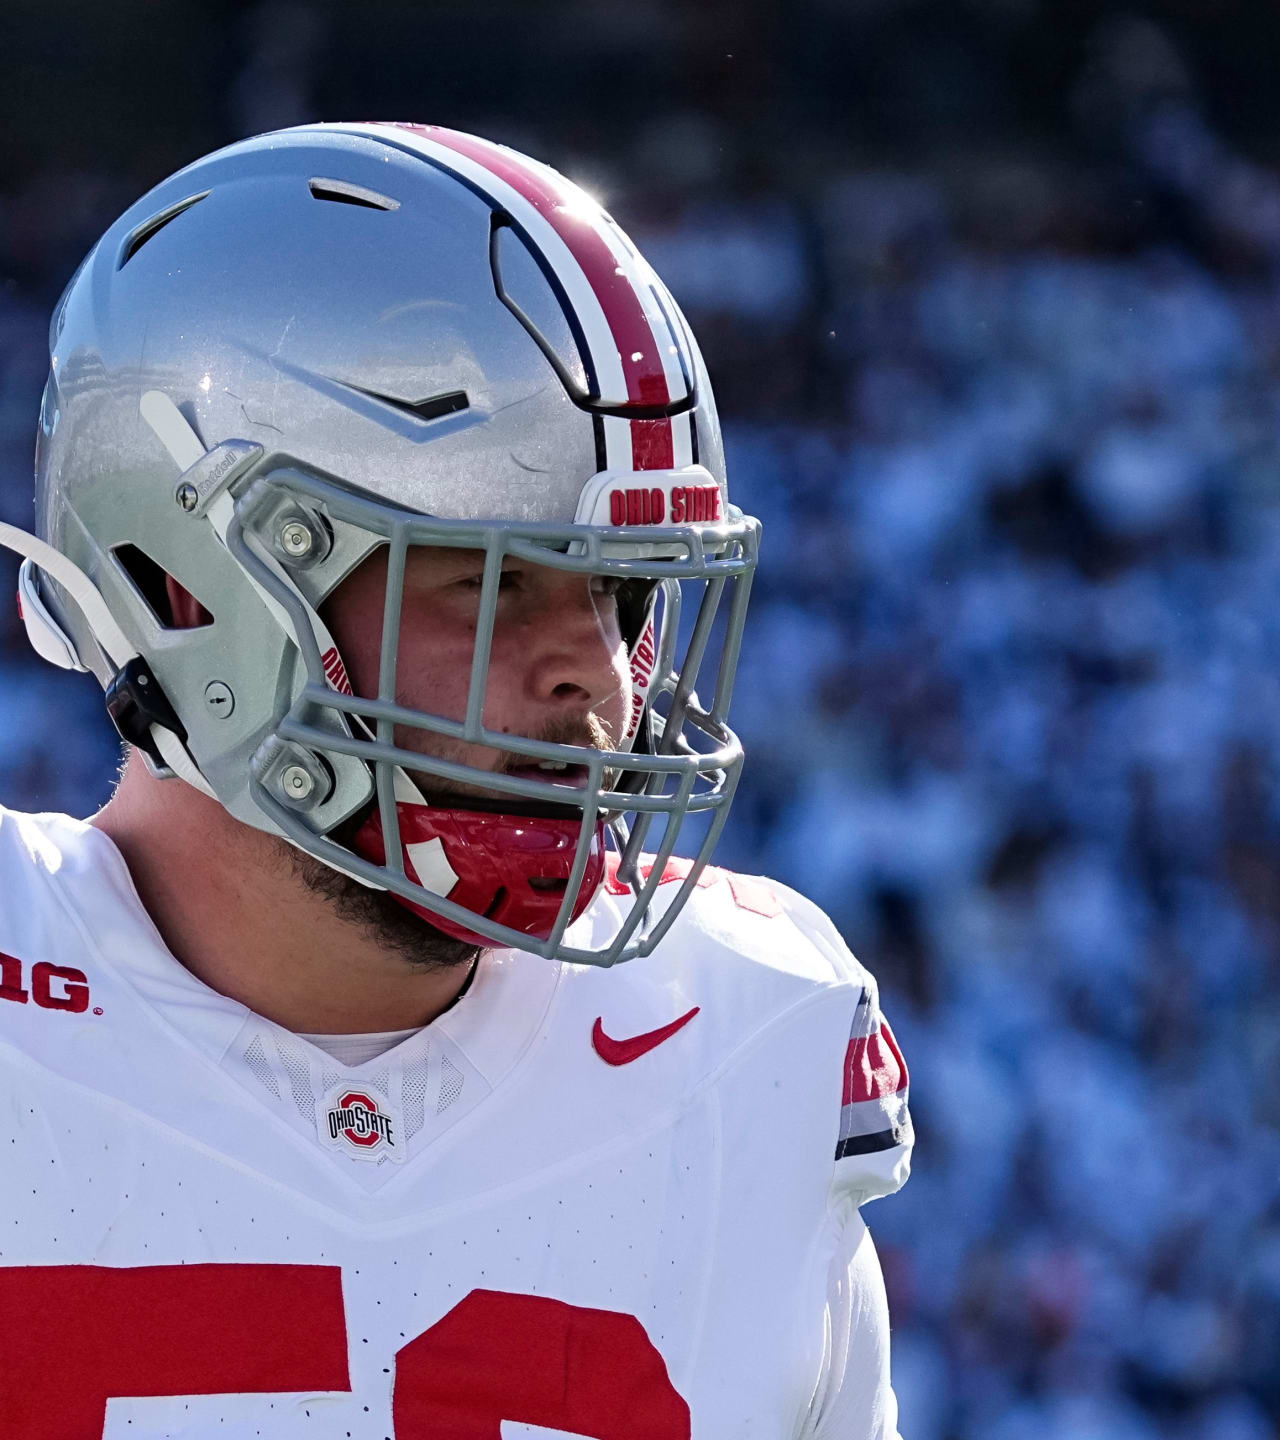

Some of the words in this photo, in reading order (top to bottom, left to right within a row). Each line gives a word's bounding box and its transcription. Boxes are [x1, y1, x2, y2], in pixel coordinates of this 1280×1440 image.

[610, 488, 665, 527] OHIO
[671, 486, 720, 523] STATE
[328, 1110, 355, 1139] OHIO
